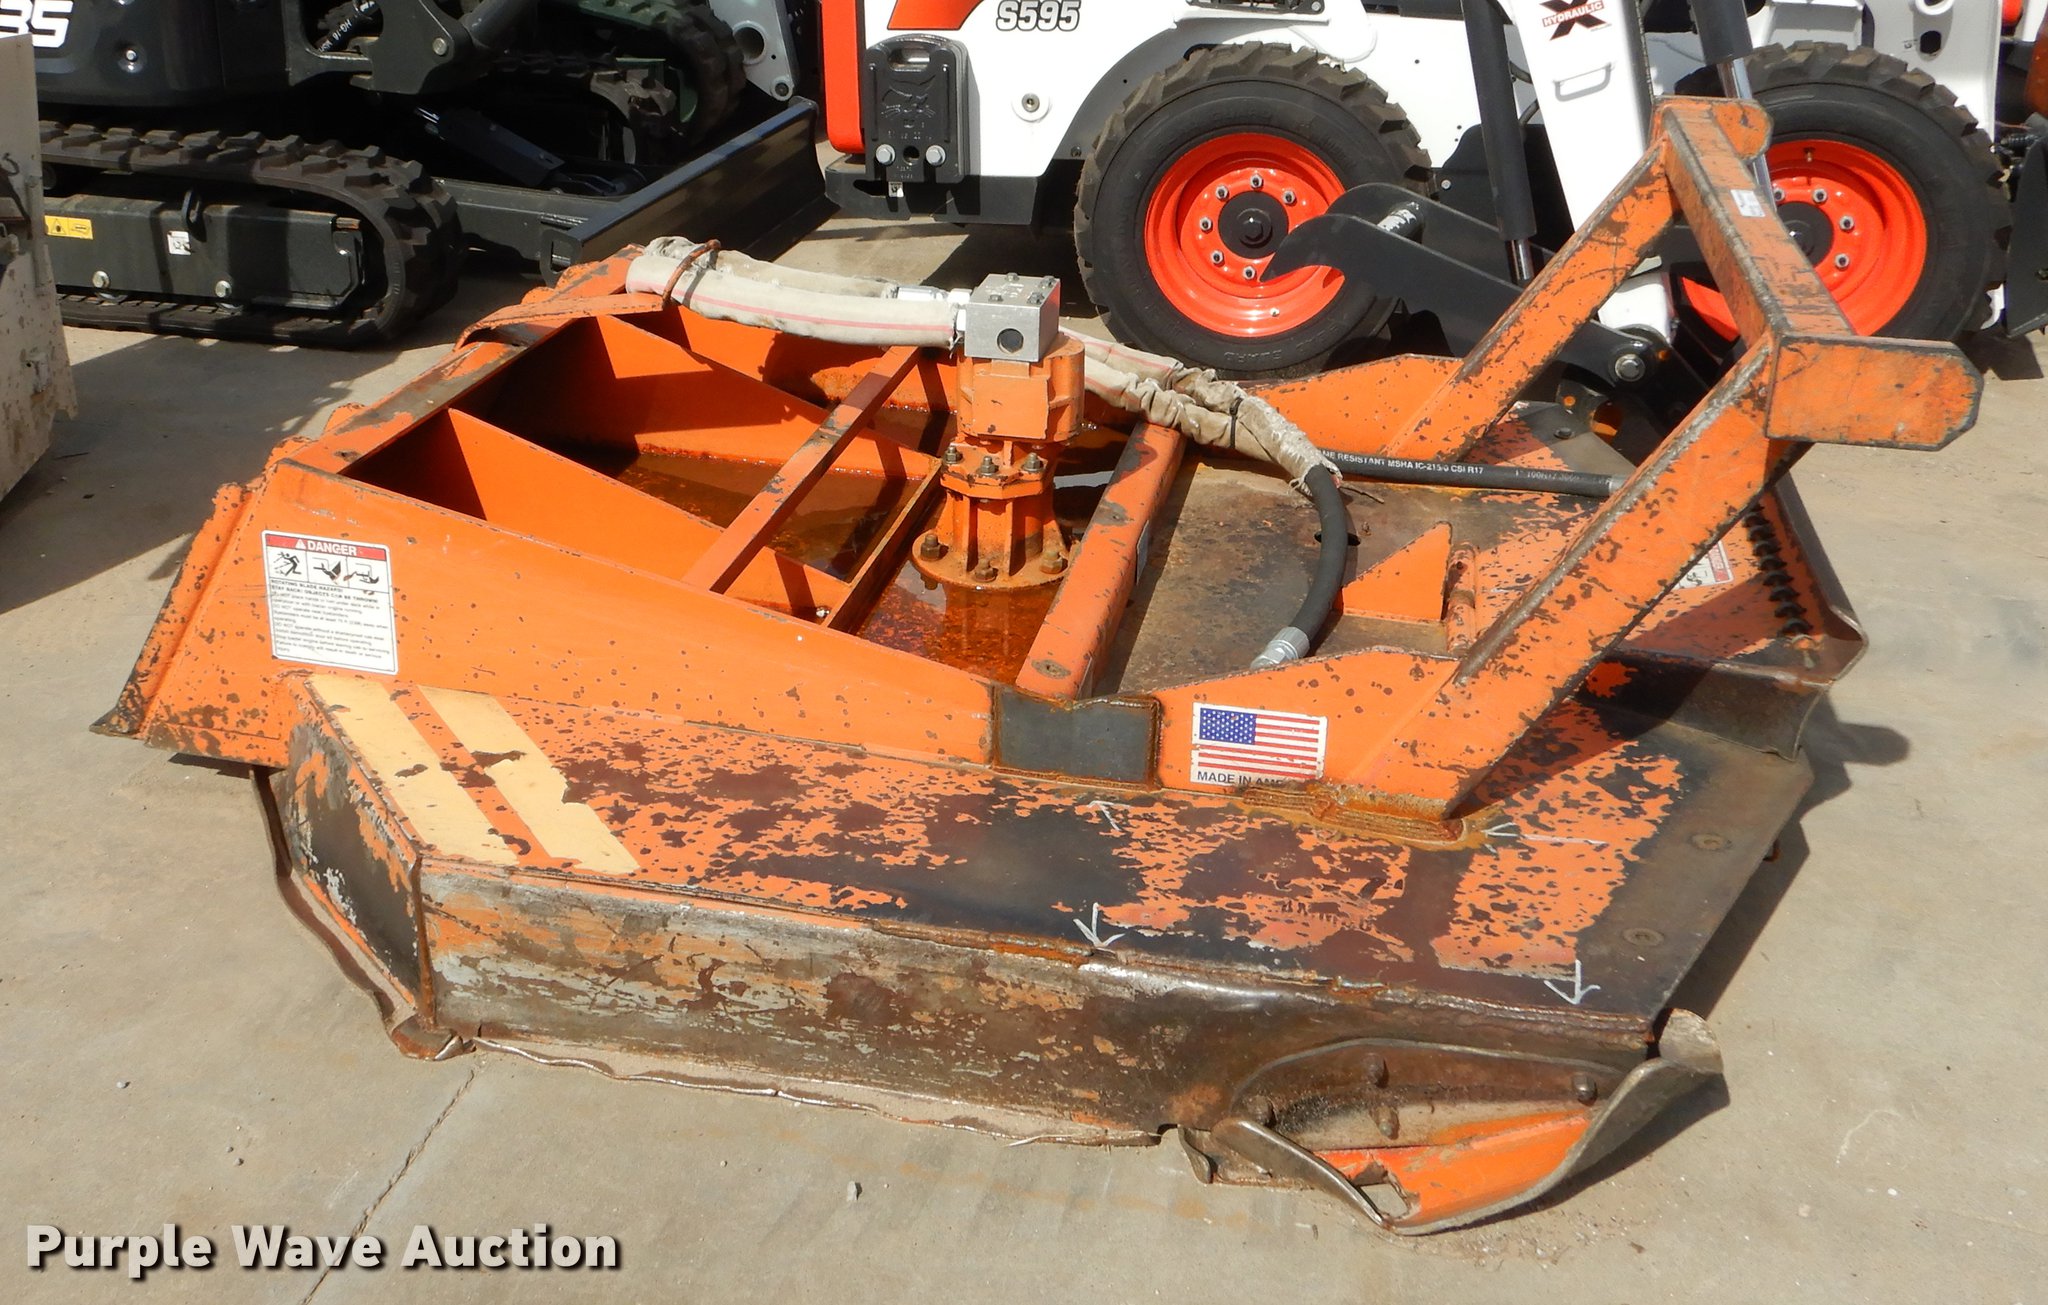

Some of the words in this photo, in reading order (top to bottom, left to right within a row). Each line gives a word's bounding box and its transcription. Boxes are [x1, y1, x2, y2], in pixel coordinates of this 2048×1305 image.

[996, 0, 1081, 32] S595
[1542, 1, 1604, 27] HYDRAULIC
[1337, 452, 1385, 466] RESISTANT
[1387, 459, 1413, 469] MSHA
[1467, 466, 1484, 475] R17
[307, 540, 358, 557] DANGER
[1197, 771, 1235, 784] MADE
[1239, 775, 1252, 786] IN
